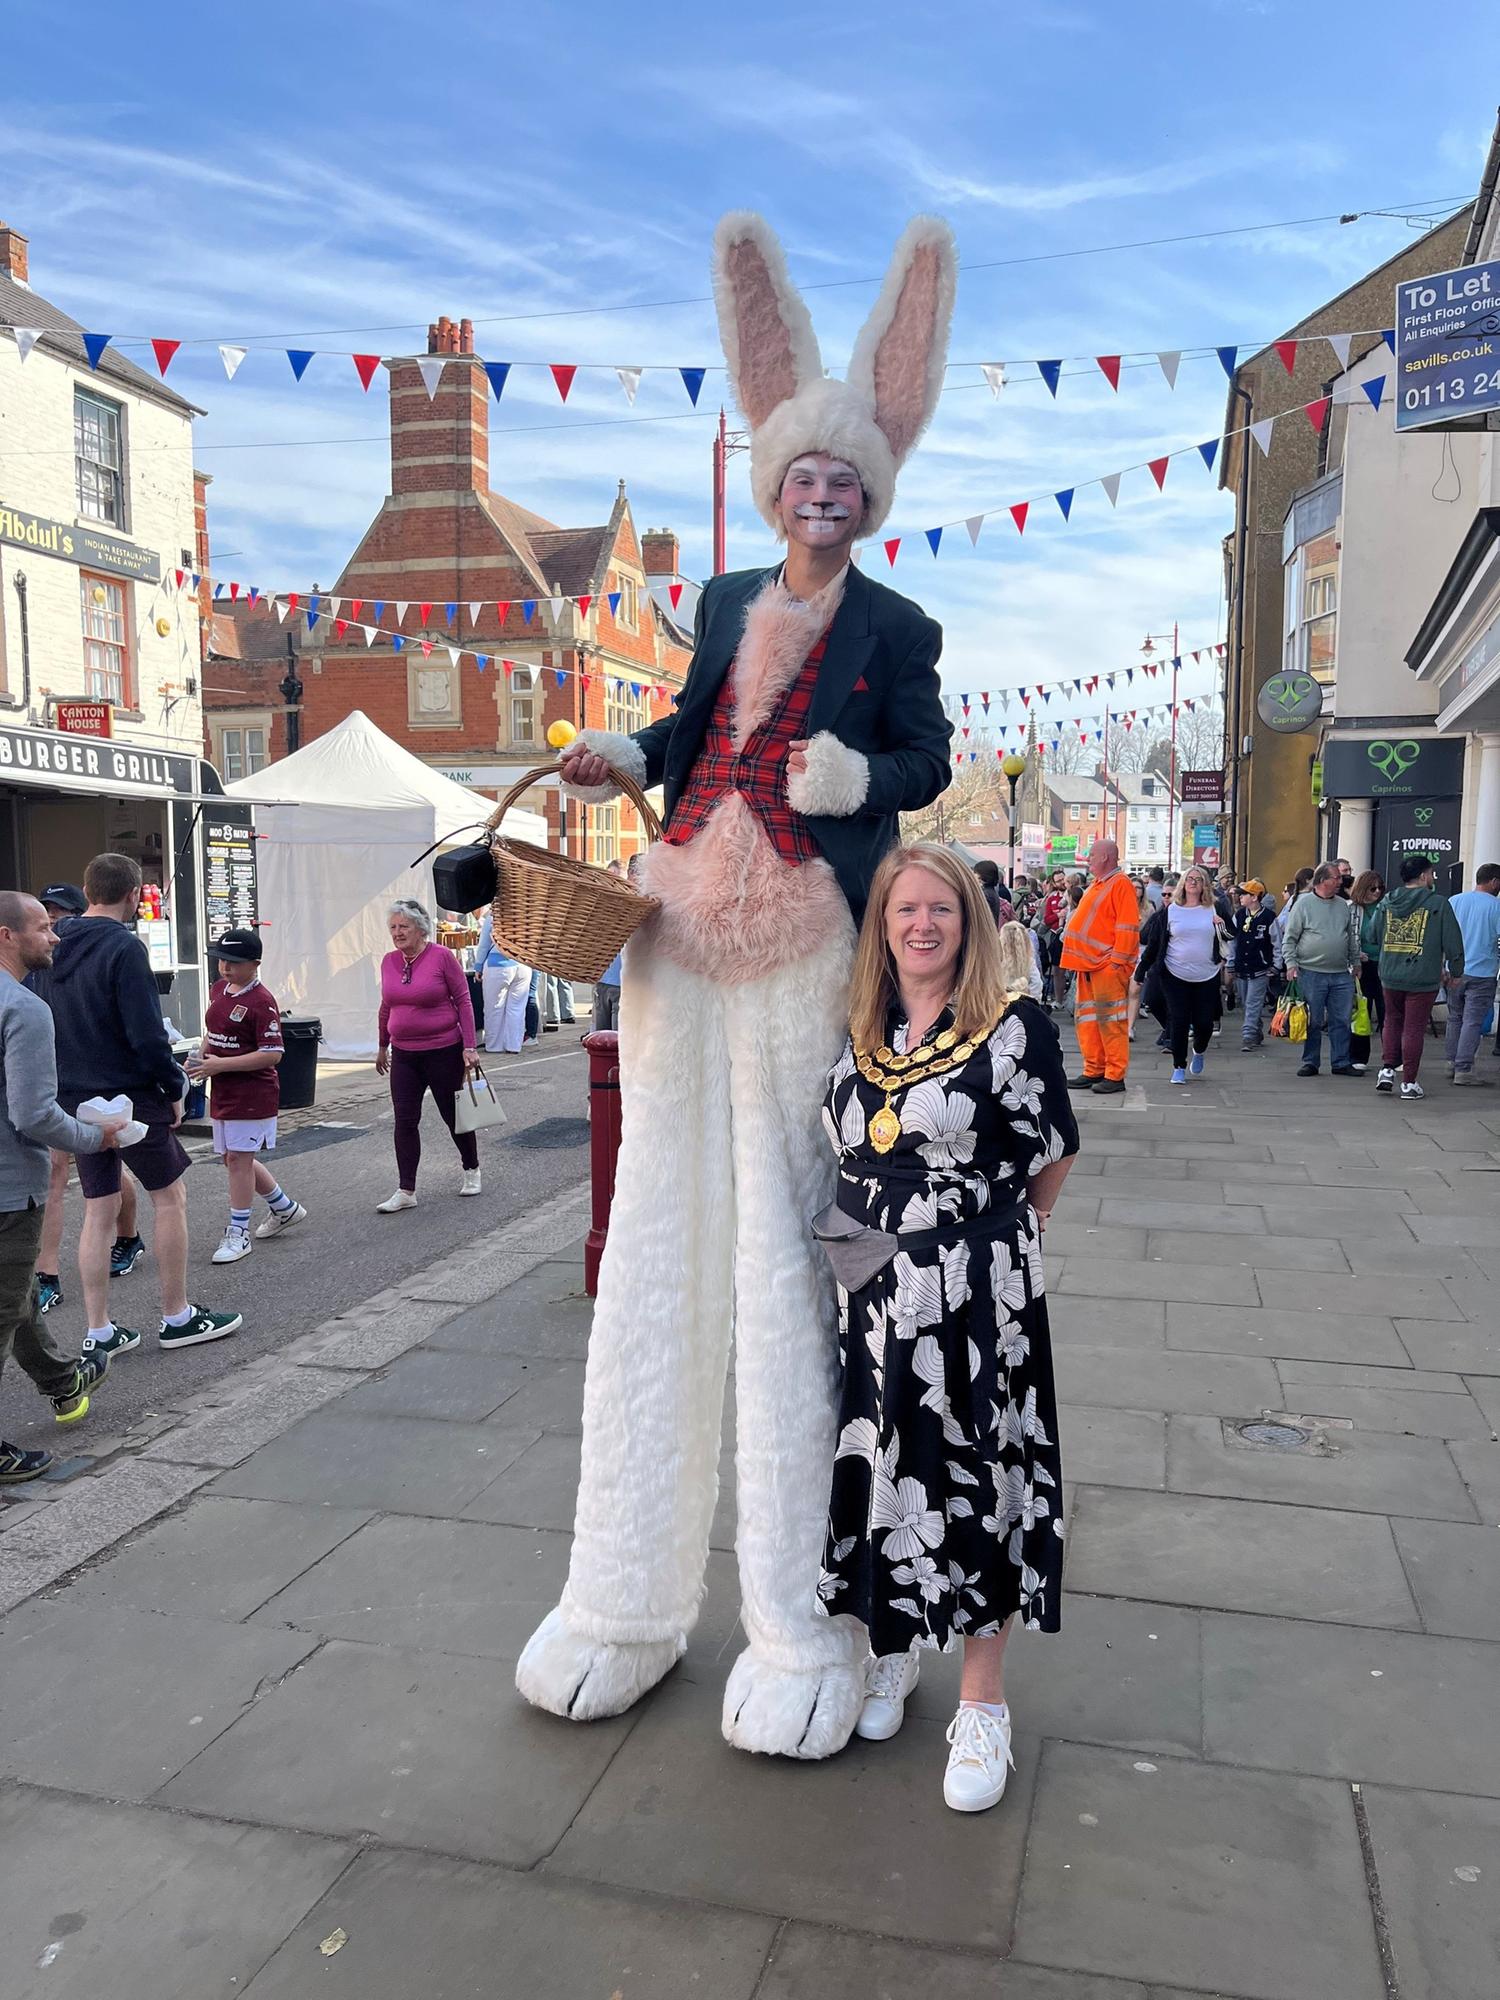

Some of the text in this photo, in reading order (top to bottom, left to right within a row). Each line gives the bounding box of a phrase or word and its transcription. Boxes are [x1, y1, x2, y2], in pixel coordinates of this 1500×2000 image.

[1404, 271, 1491, 311] To Let
[1404, 312, 1432, 328] First
[1435, 305, 1468, 320] Floor
[1404, 320, 1466, 342] All Enquiries
[1405, 342, 1493, 372] savills.co.uk
[1405, 369, 1500, 410] 0113 24
[0, 510, 74, 555] Abdul's
[84, 538, 110, 553] INDIAN
[111, 545, 152, 564] RESTAURANT
[105, 553, 122, 565] TAKE
[123, 558, 142, 569] AWAY
[61, 706, 105, 718] CANTON
[1272, 715, 1306, 724] Caprinos
[66, 718, 101, 730] HOUSE
[0, 736, 175, 784] BURGER GRILL
[1371, 785, 1412, 794] Caprinos
[1392, 839, 1452, 851] 2 TOPPINGS
